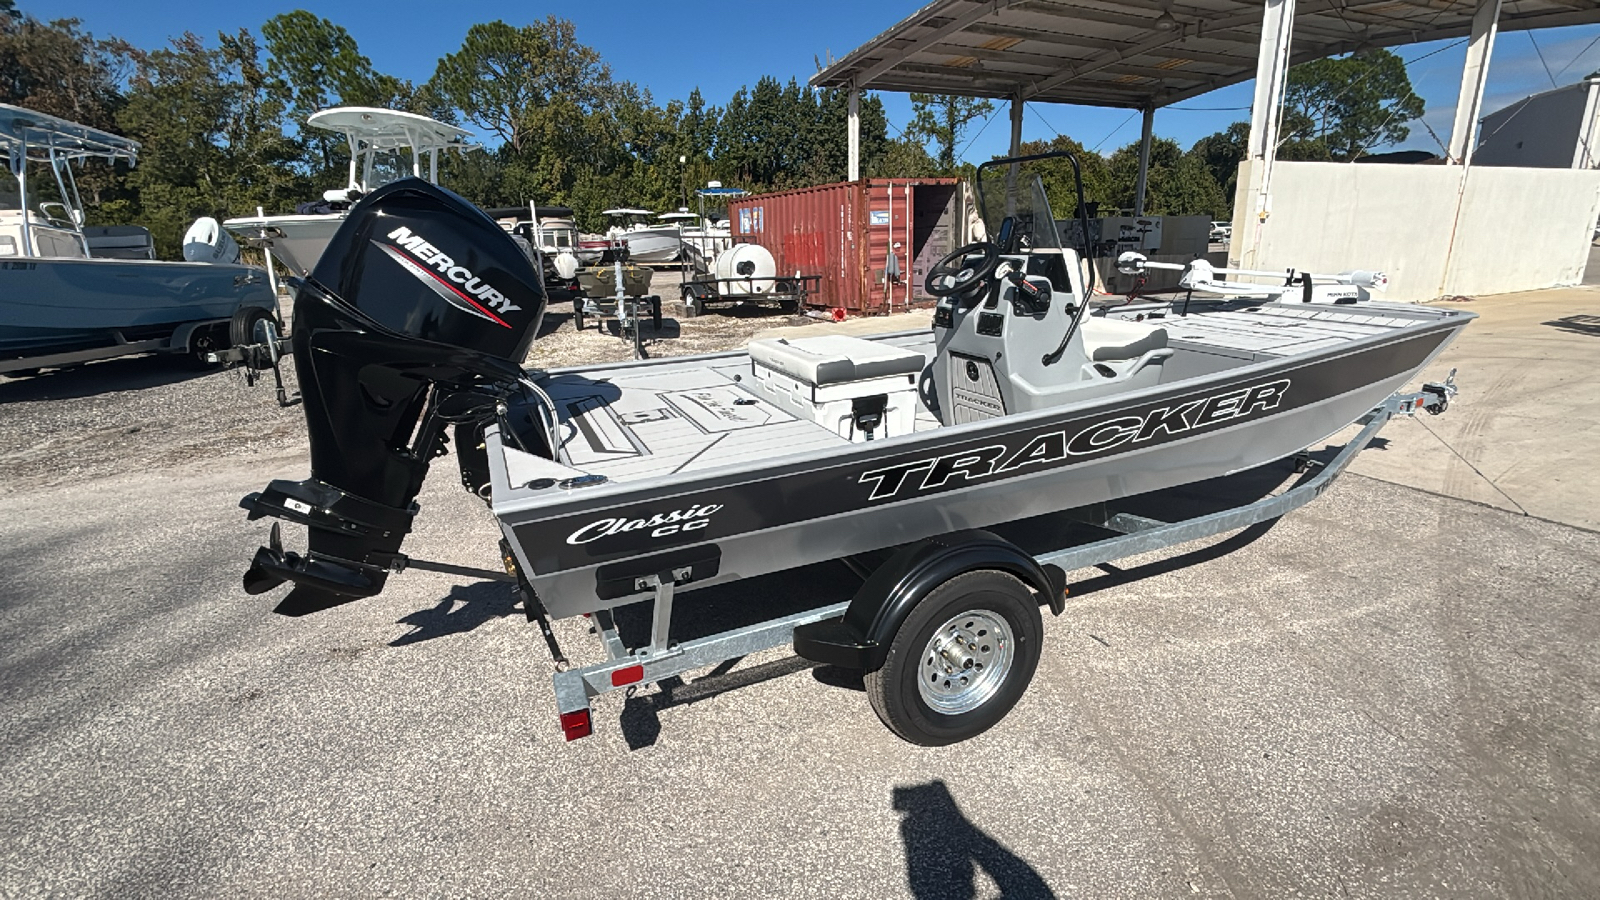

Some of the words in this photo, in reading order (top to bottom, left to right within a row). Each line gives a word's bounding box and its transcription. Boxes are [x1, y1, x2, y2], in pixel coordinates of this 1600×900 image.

[387, 226, 522, 314] MERCURY
[955, 393, 1001, 411] TRACKER
[857, 379, 1291, 501] TRACKER
[566, 504, 724, 545] Classic
[651, 518, 710, 538] CC
